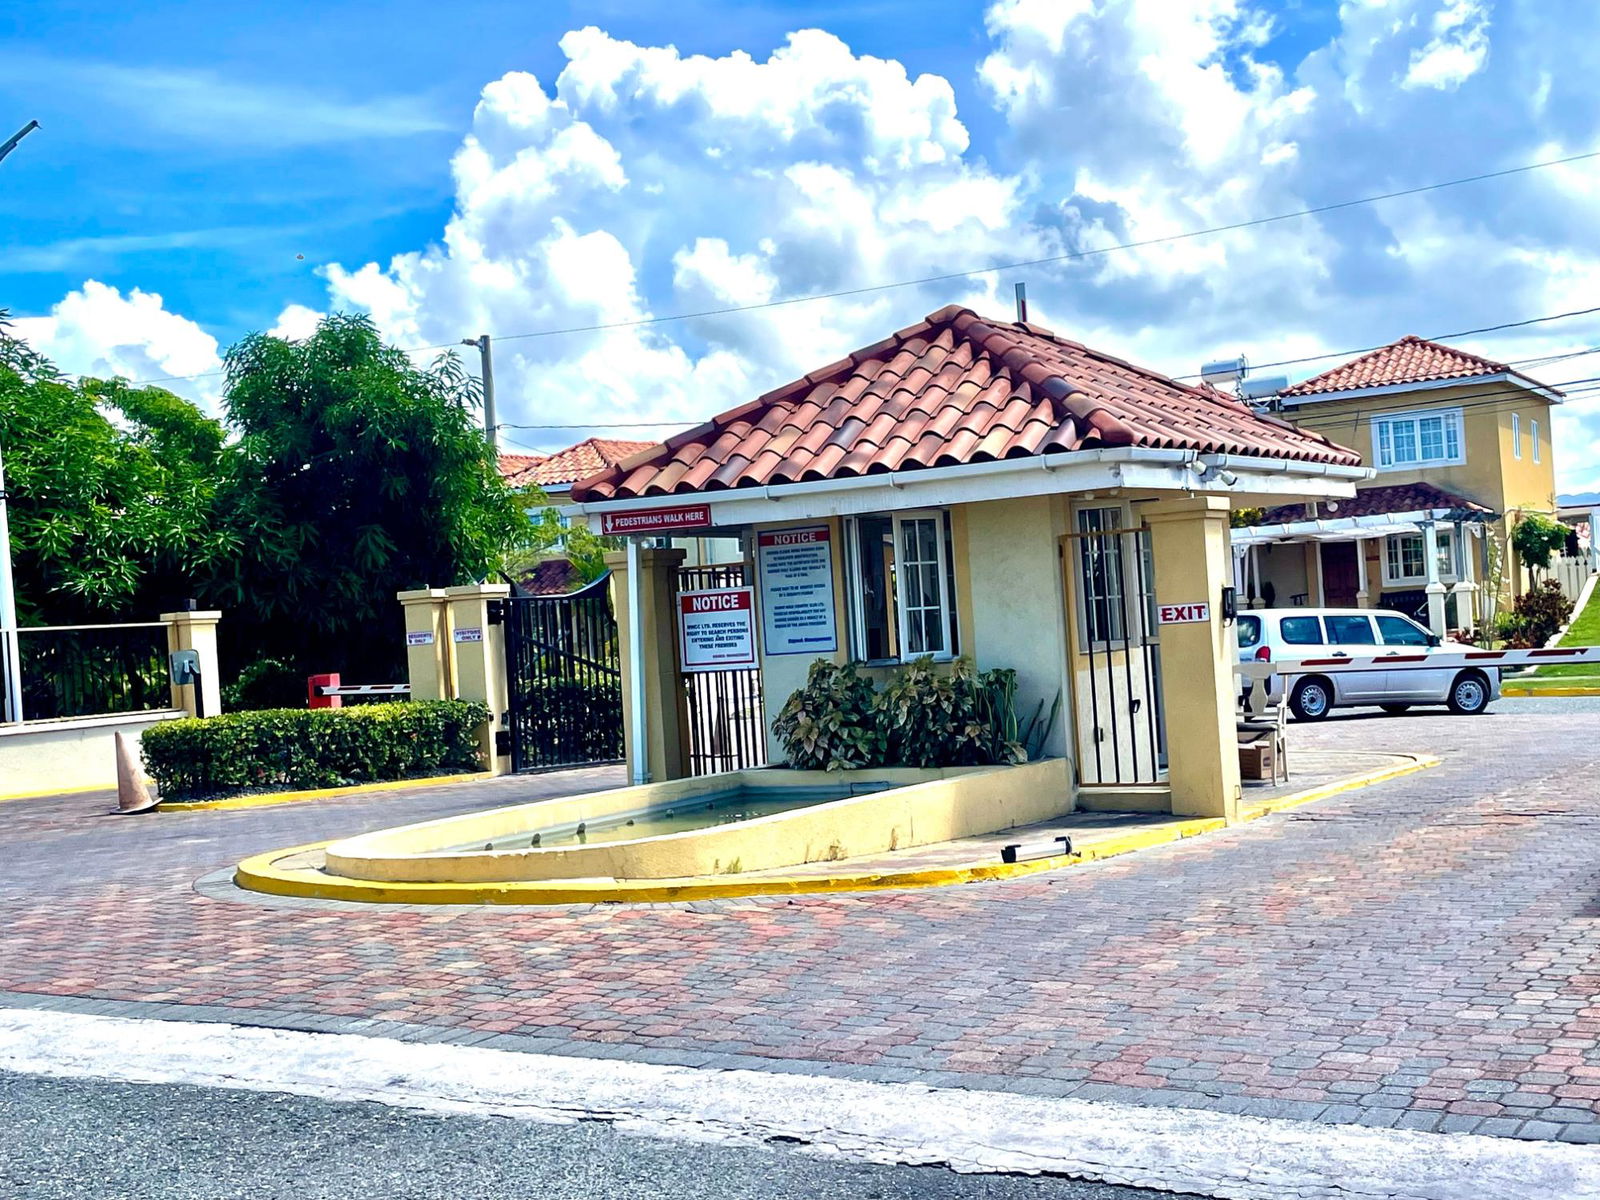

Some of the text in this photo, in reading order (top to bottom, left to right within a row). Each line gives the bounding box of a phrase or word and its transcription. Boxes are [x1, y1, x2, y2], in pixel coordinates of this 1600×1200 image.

[615, 511, 704, 527] PEDESTRIANS WALK HERE
[774, 532, 816, 545] NOTICE
[692, 594, 739, 611] NOTICE
[1161, 605, 1205, 621] EXIT
